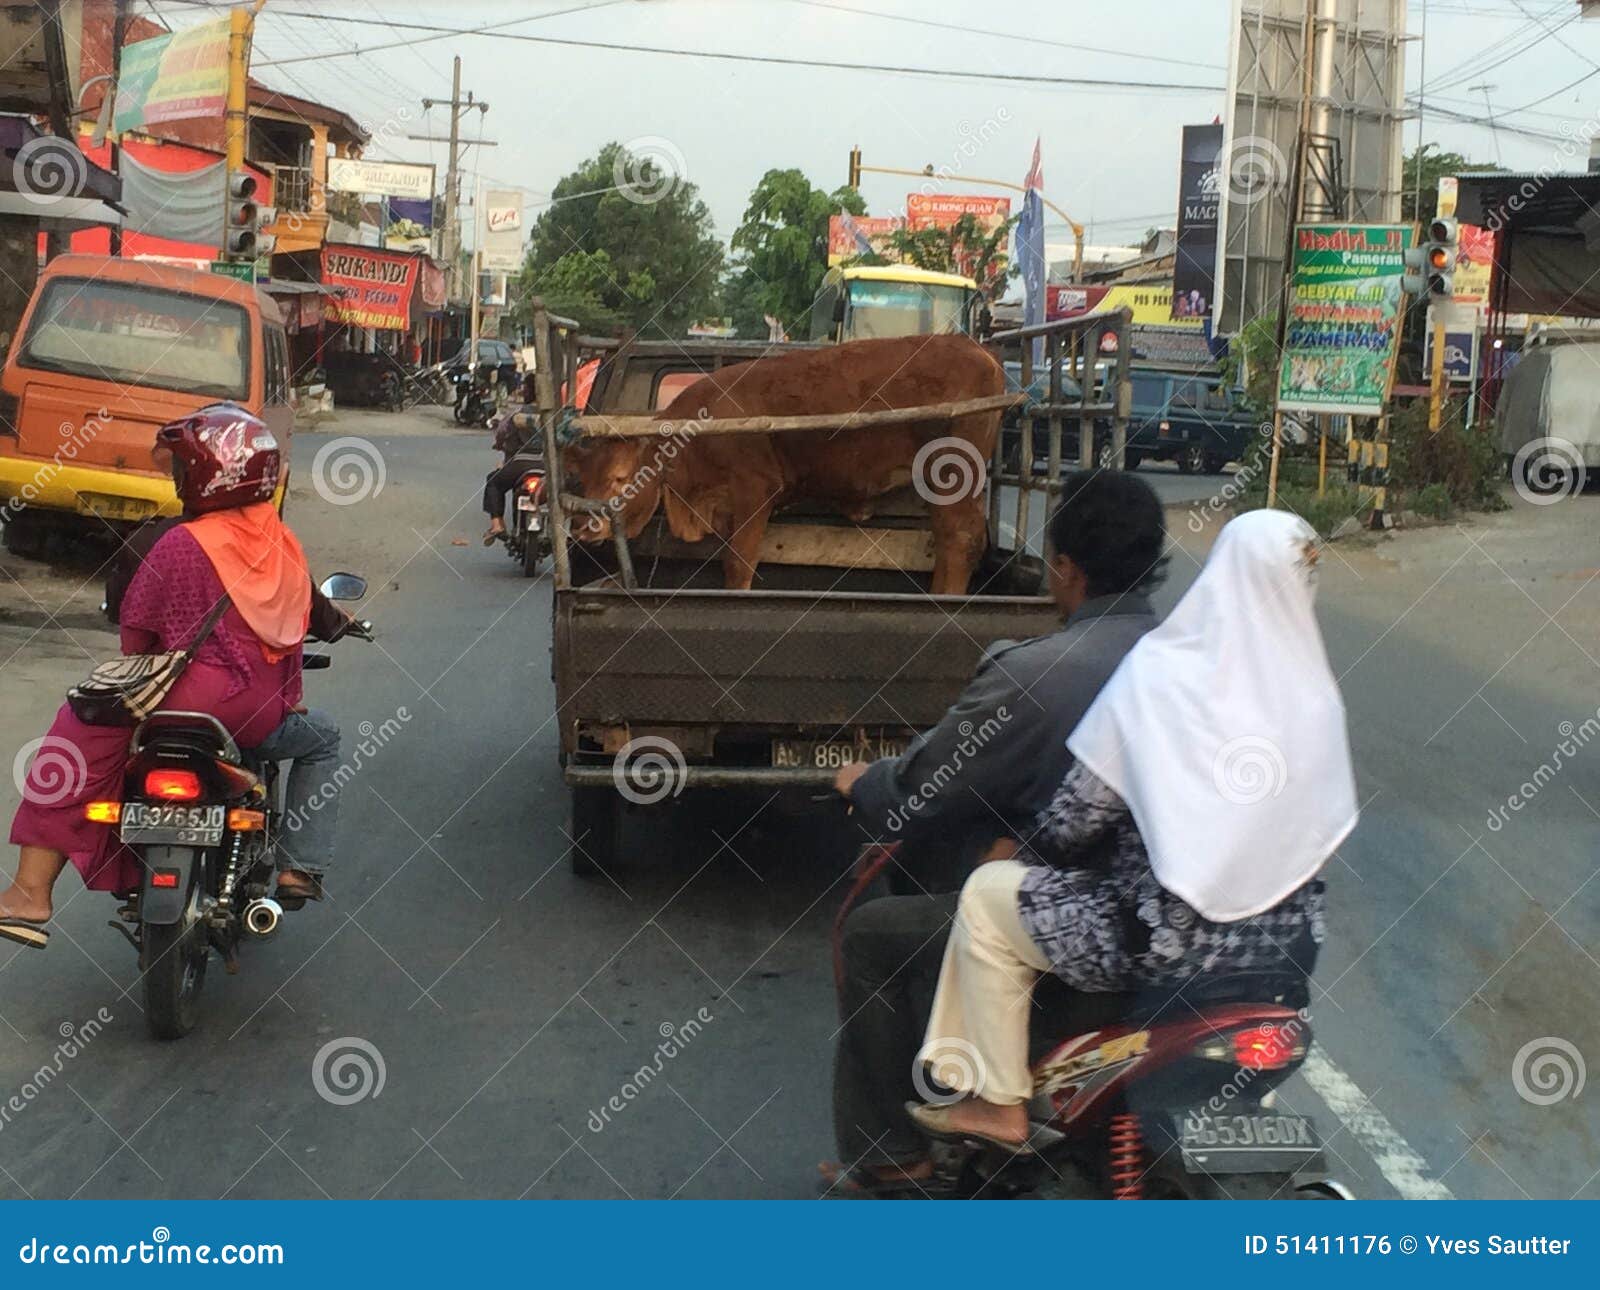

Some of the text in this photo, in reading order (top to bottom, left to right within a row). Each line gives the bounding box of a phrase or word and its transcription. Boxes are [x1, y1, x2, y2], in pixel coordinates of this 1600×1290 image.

[932, 202, 993, 214] KHONG GUAN
[1342, 251, 1403, 265] Pameran
[326, 253, 409, 286] SRIKANDI
[1290, 328, 1388, 348] PAMERAN
